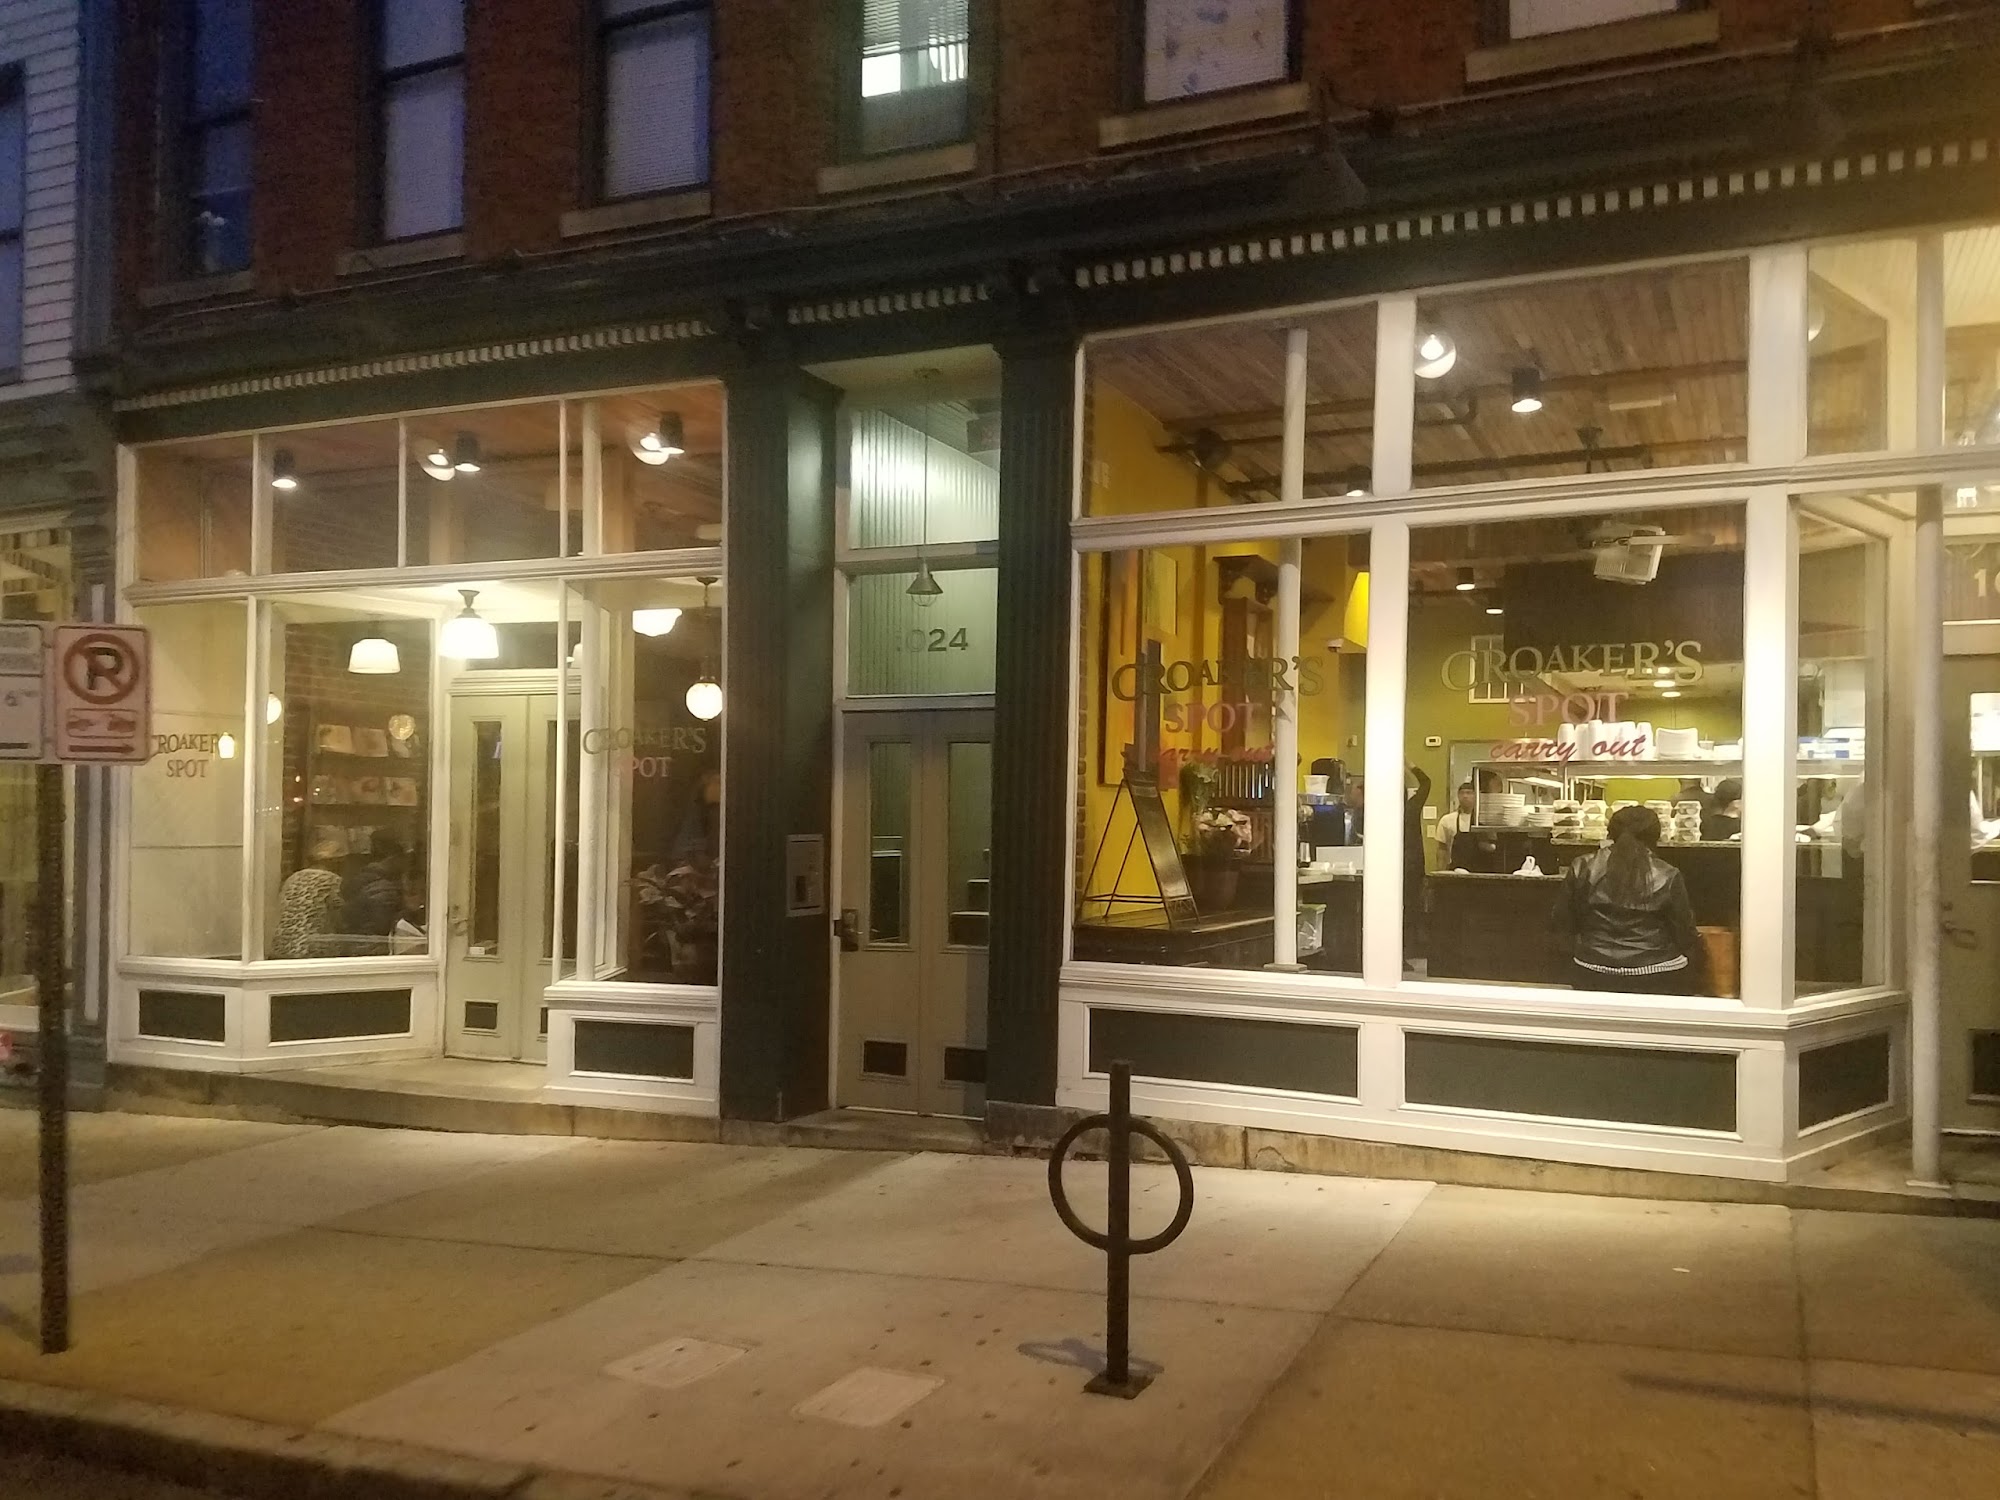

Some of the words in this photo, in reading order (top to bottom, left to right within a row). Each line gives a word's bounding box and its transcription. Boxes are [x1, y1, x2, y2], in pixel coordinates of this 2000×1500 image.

[1441, 640, 1704, 691] CROAKER'S
[1164, 702, 1262, 734] SPOT
[1509, 691, 1630, 727] SPOT
[1490, 738, 1577, 766] carry
[1592, 734, 1646, 757] out
[166, 759, 209, 778] SPOT
[614, 756, 673, 778] POT
